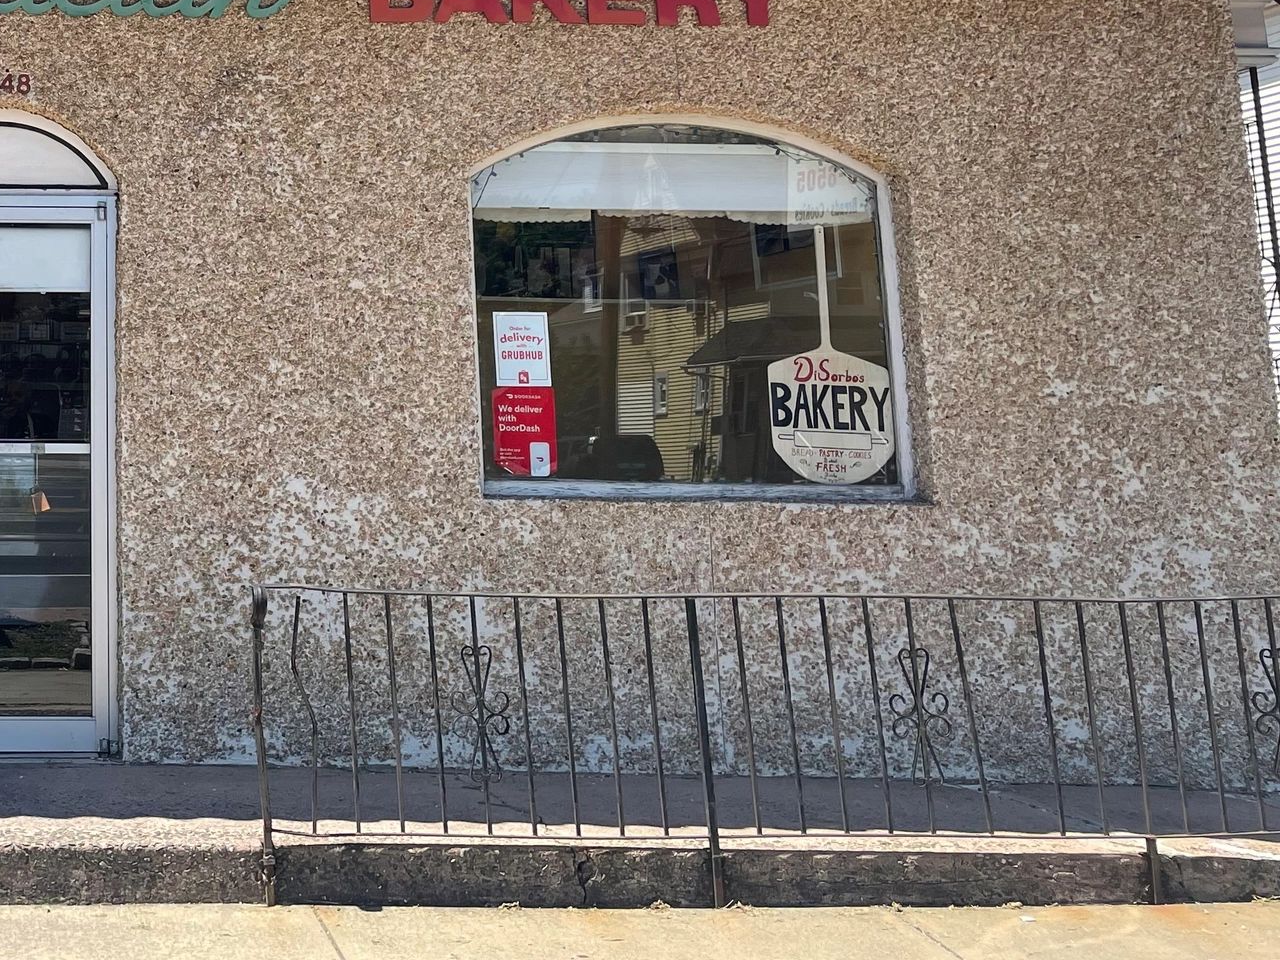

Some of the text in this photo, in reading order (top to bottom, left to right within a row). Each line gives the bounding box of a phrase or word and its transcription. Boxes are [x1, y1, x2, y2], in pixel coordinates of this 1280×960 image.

[500, 332, 544, 345] delivery
[501, 350, 544, 360] GRUBHUB
[498, 404, 543, 413] We deliver
[770, 382, 890, 432] BAKERY
[498, 414, 517, 422] with
[499, 423, 541, 433] DoorDash
[791, 448, 813, 457] BREAD
[819, 449, 844, 458] PASTRY
[816, 462, 847, 473] FRESH
